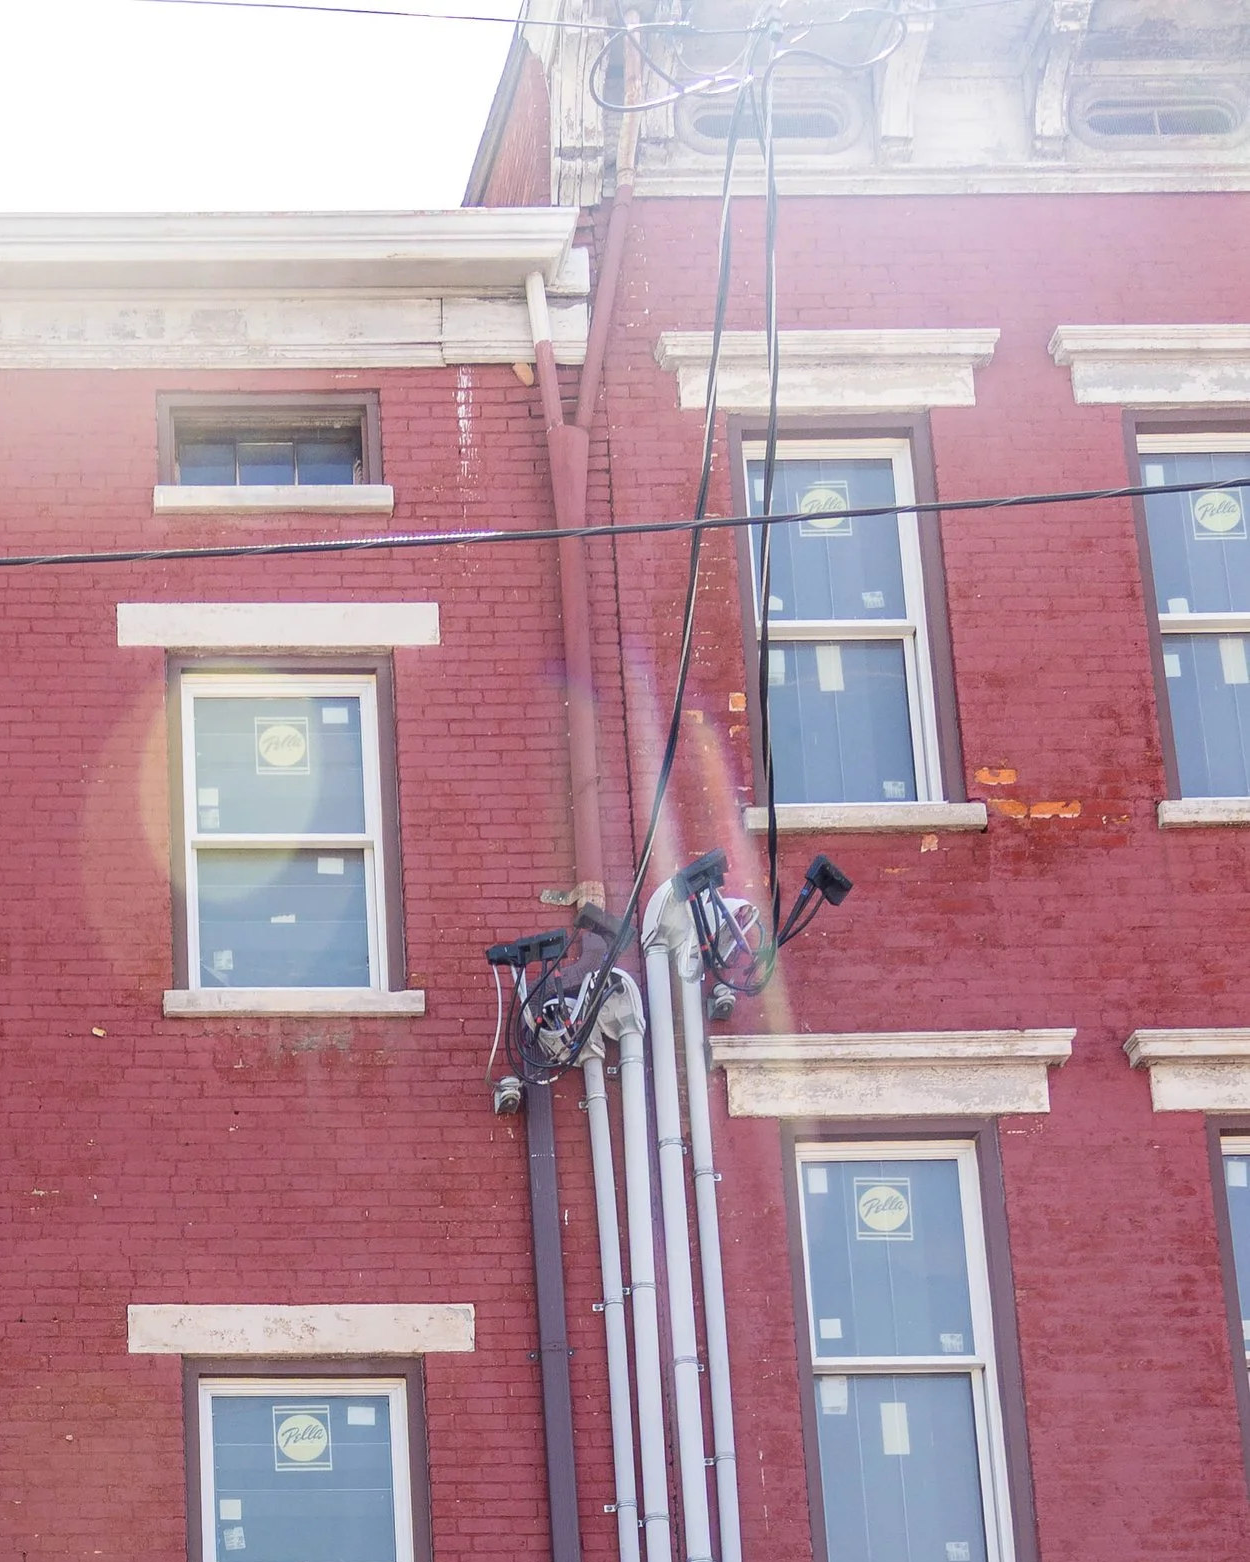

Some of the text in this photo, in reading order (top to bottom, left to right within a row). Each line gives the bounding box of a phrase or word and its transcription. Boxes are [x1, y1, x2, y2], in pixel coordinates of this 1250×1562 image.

[1198, 500, 1237, 521] Pella
[263, 733, 302, 755] Pella
[862, 1195, 905, 1218] Pella
[281, 1424, 324, 1449] Pella
